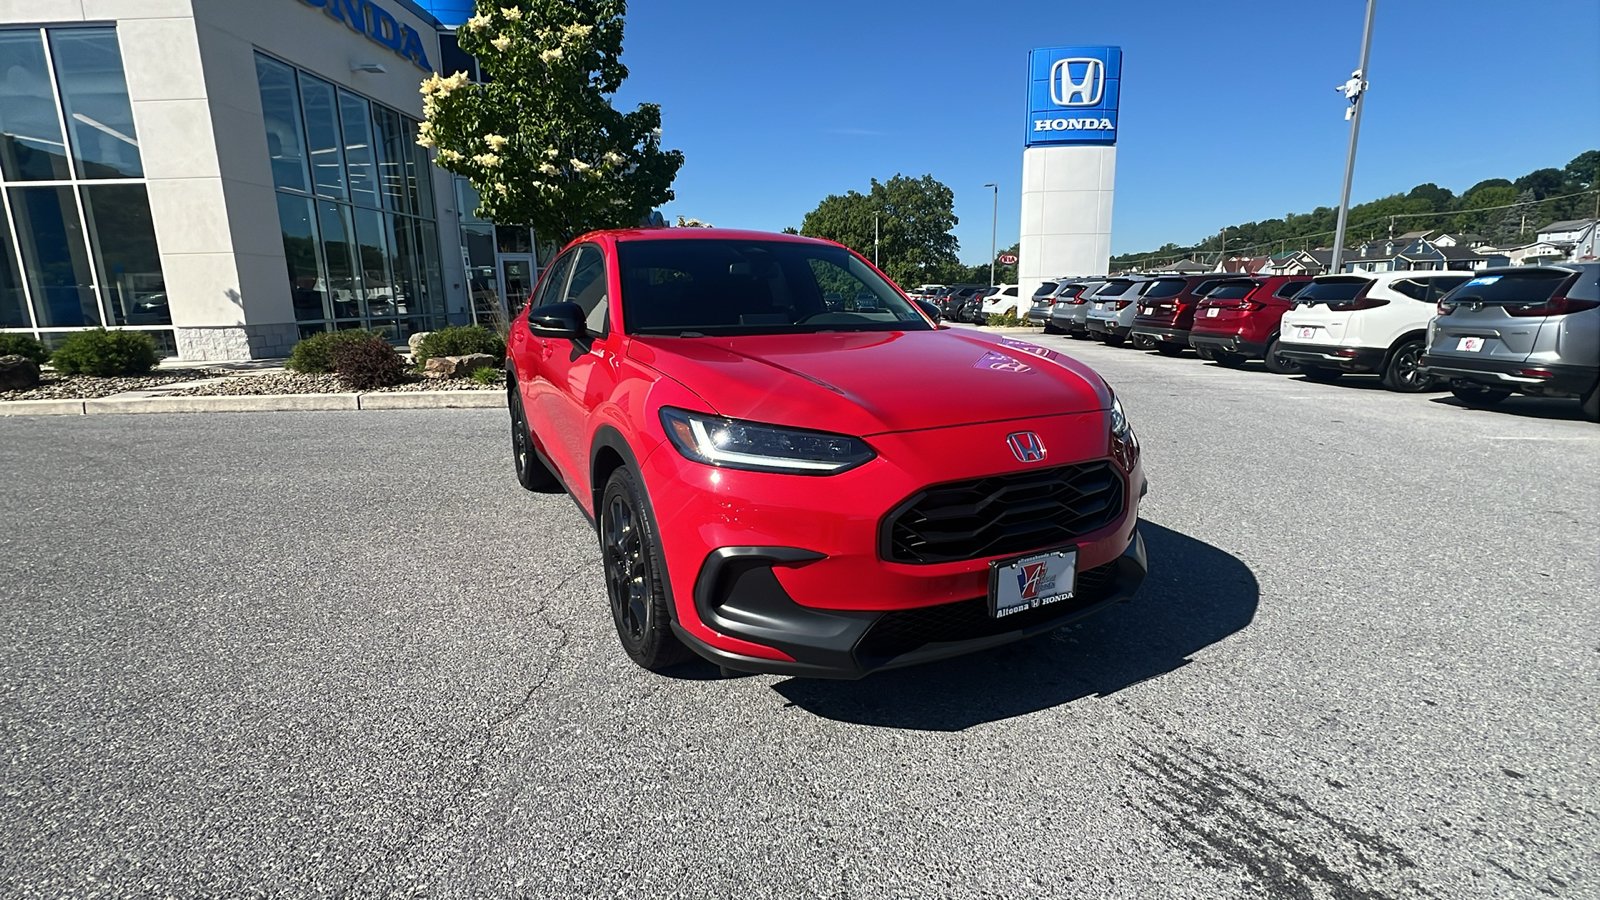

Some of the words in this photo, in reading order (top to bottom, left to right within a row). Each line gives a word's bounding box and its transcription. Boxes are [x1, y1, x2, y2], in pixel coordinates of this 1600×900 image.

[1034, 118, 1115, 132] HONDA
[996, 604, 1029, 618] Altoona
[1042, 592, 1074, 605] HONDA
